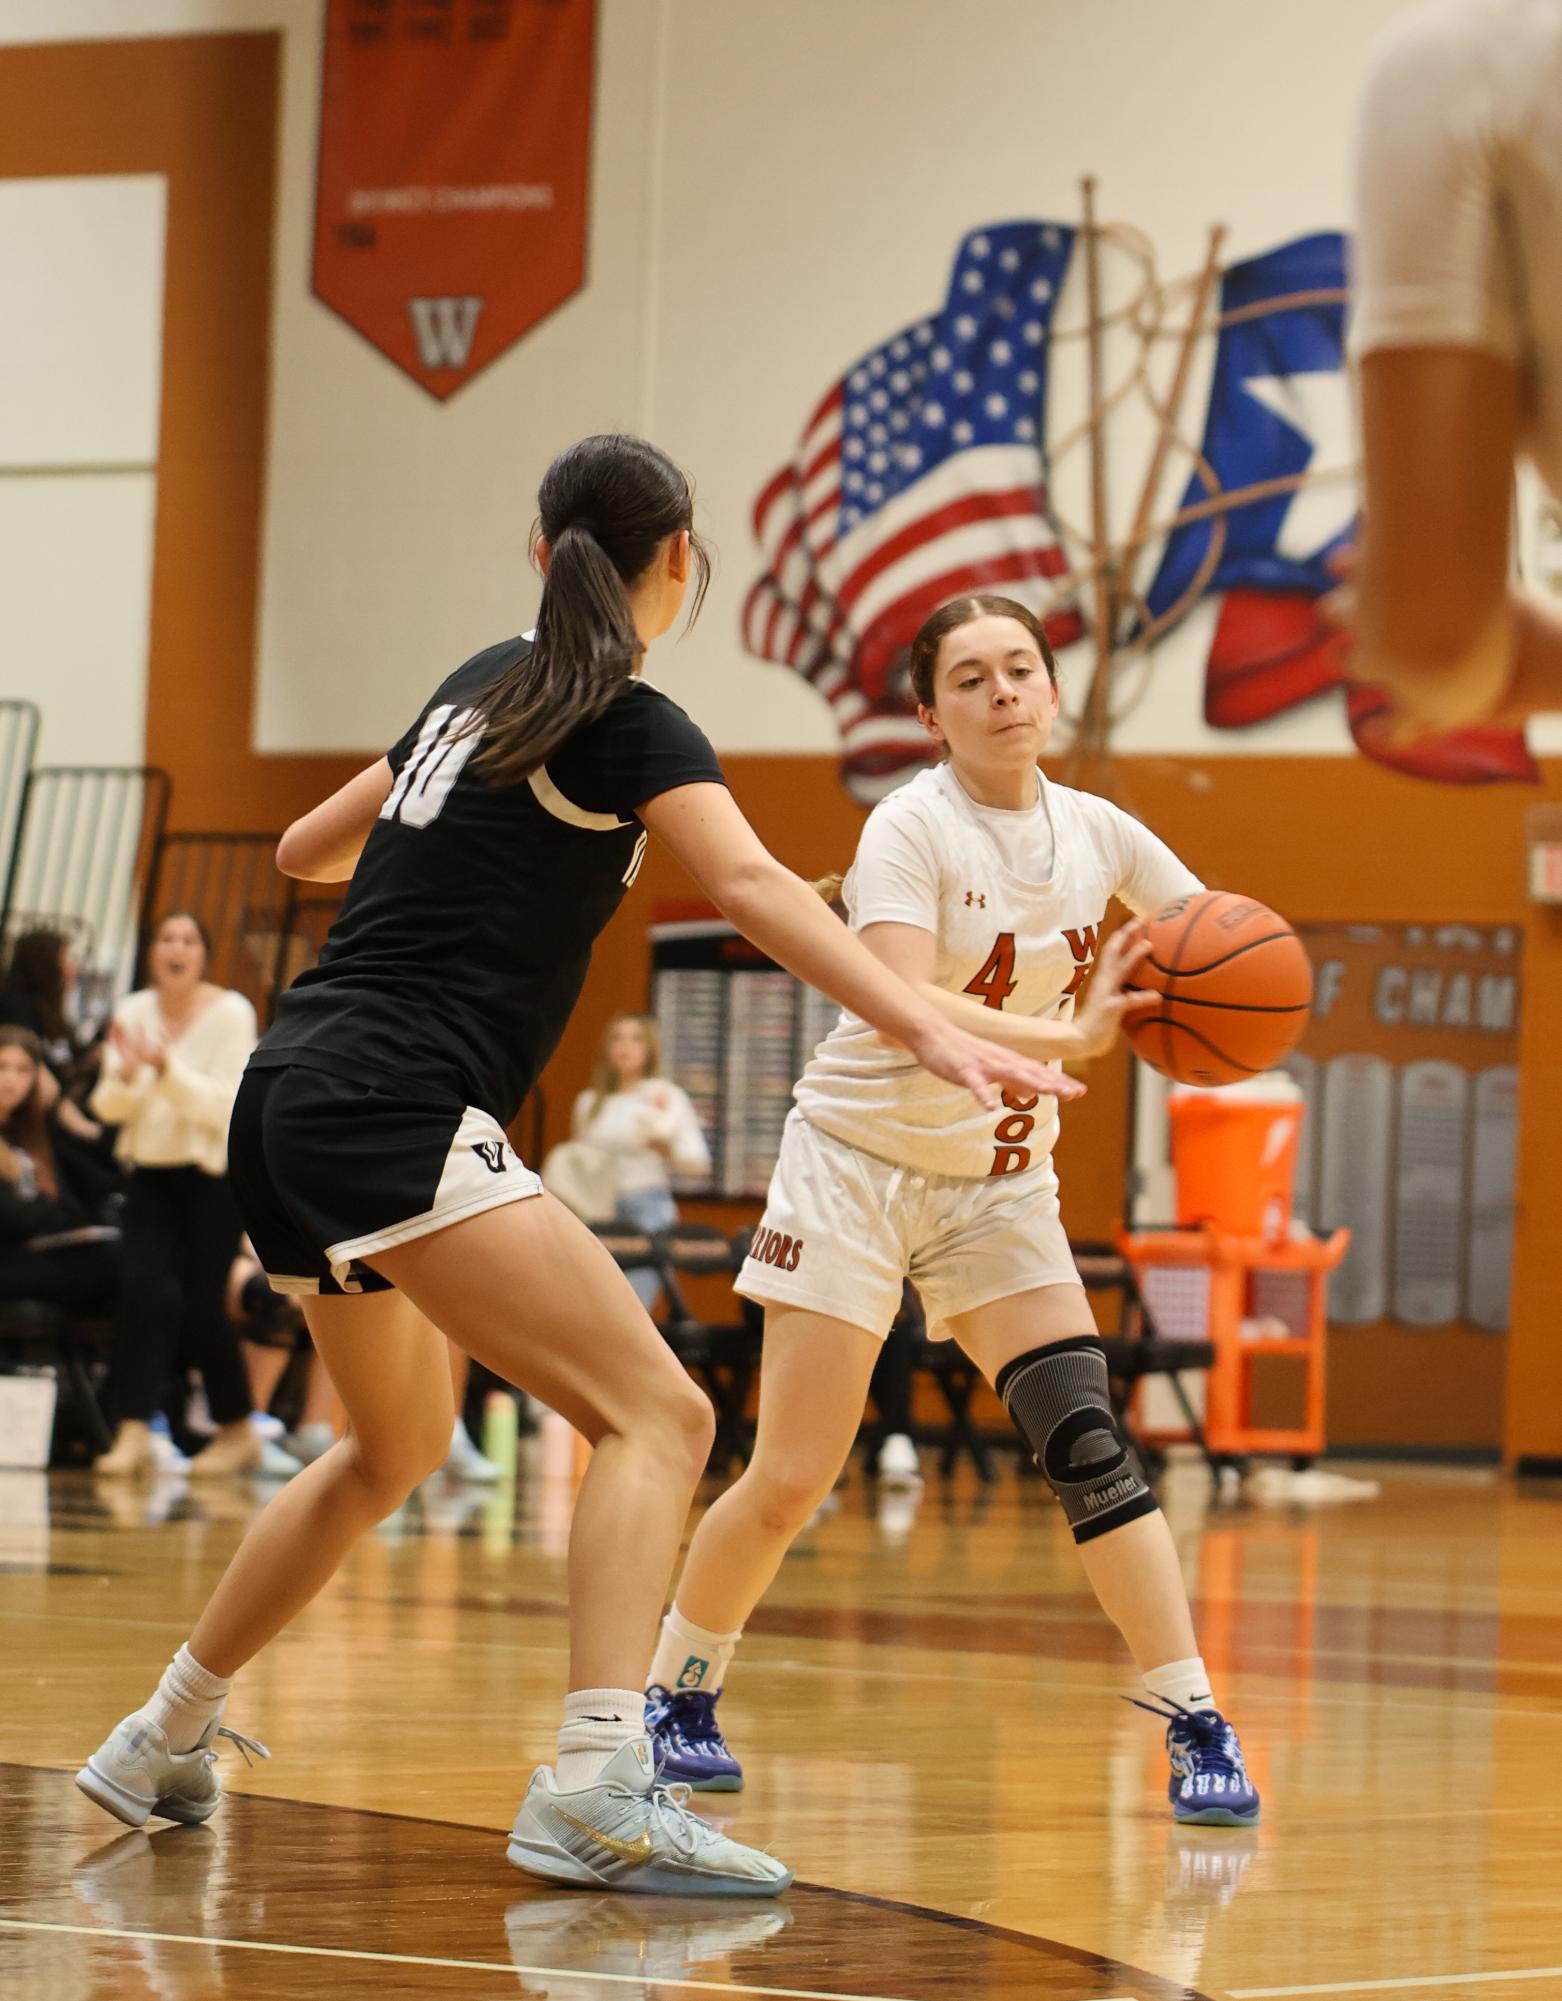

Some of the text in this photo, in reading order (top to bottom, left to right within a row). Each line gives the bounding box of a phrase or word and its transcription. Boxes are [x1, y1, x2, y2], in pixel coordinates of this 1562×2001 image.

[408, 296, 484, 369] W
[379, 703, 490, 830] 10
[962, 932, 1019, 1012] 4
[1373, 964, 1520, 1031] CHAM
[1082, 1476, 1137, 1512] Mueller
